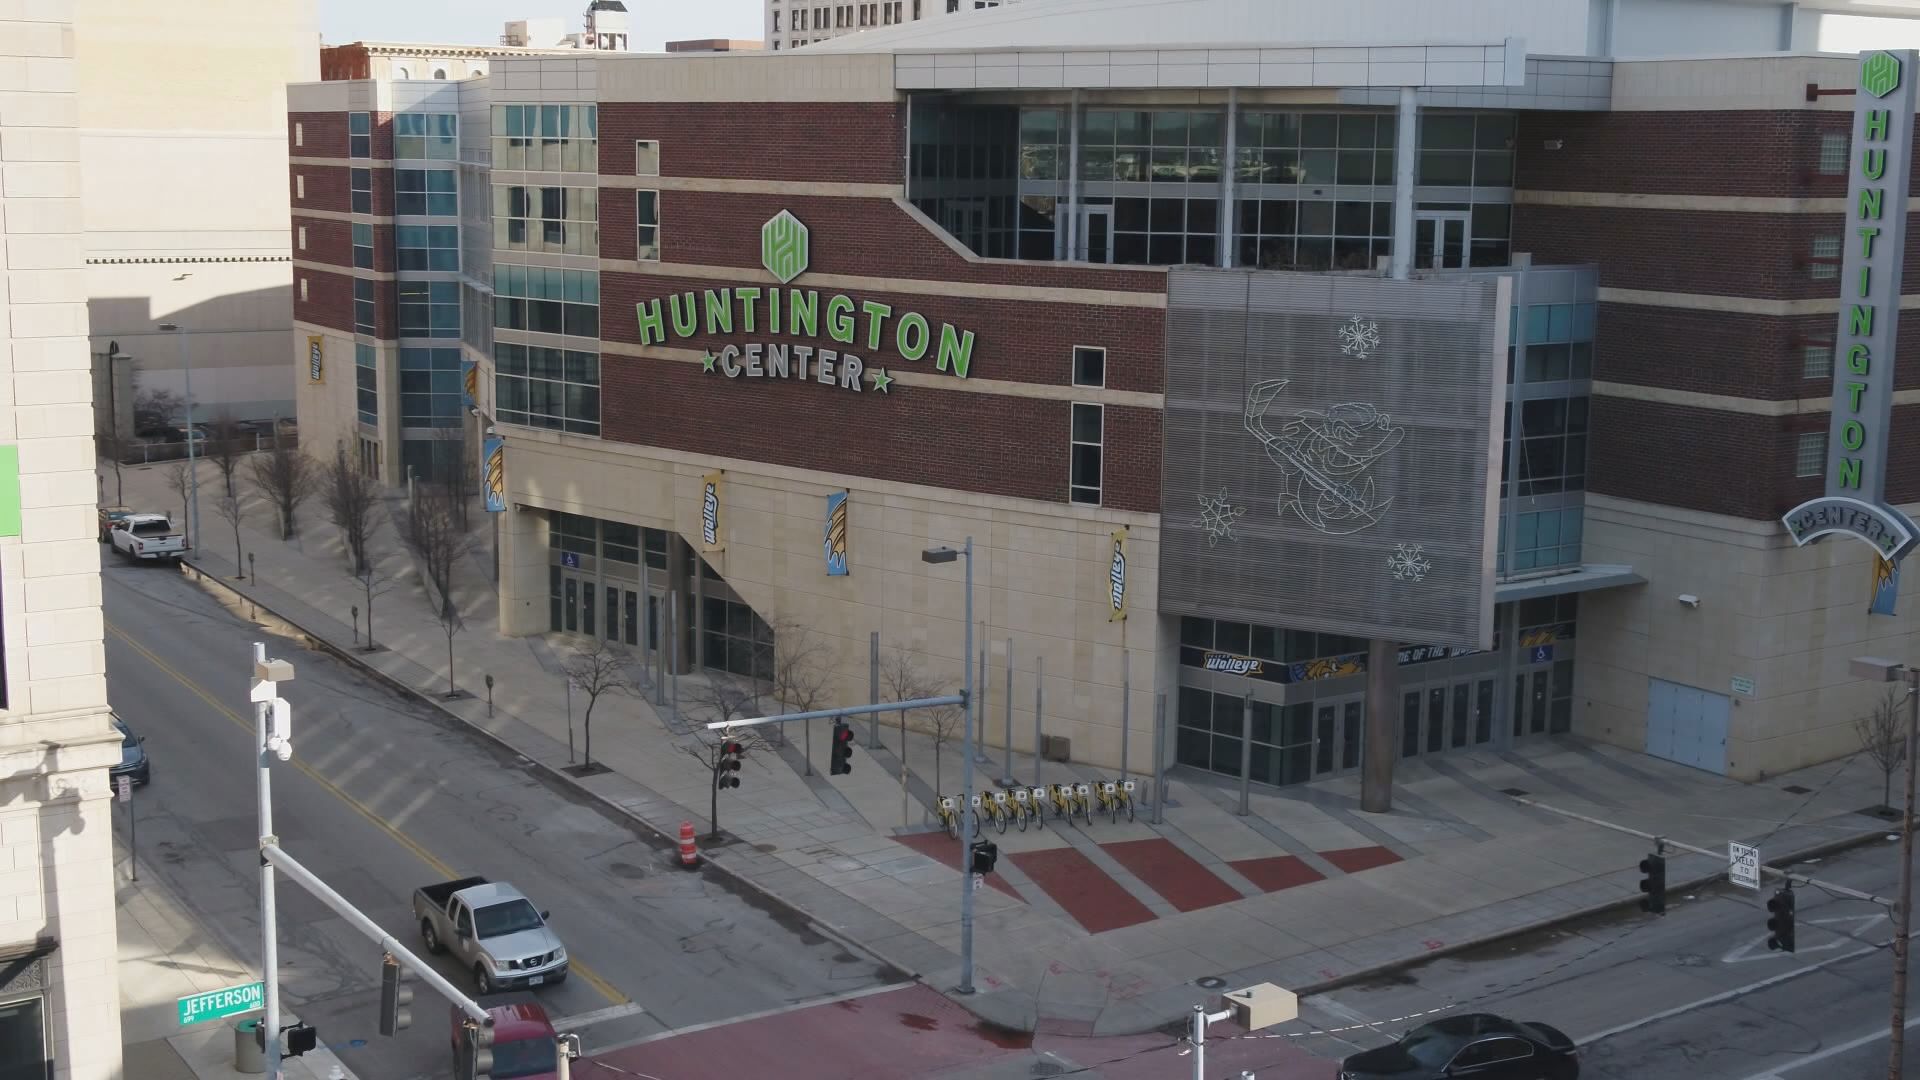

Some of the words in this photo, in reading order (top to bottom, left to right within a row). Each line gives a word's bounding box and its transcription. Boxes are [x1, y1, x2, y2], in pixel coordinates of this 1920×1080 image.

[1838, 109, 1890, 489] HUNTINGTON
[635, 287, 975, 379] HUNTINGTON
[721, 343, 863, 392] CENTER
[1803, 506, 1884, 540] CENTER
[1206, 658, 1259, 675] Walleye
[183, 984, 261, 1016] JEFFERSON
